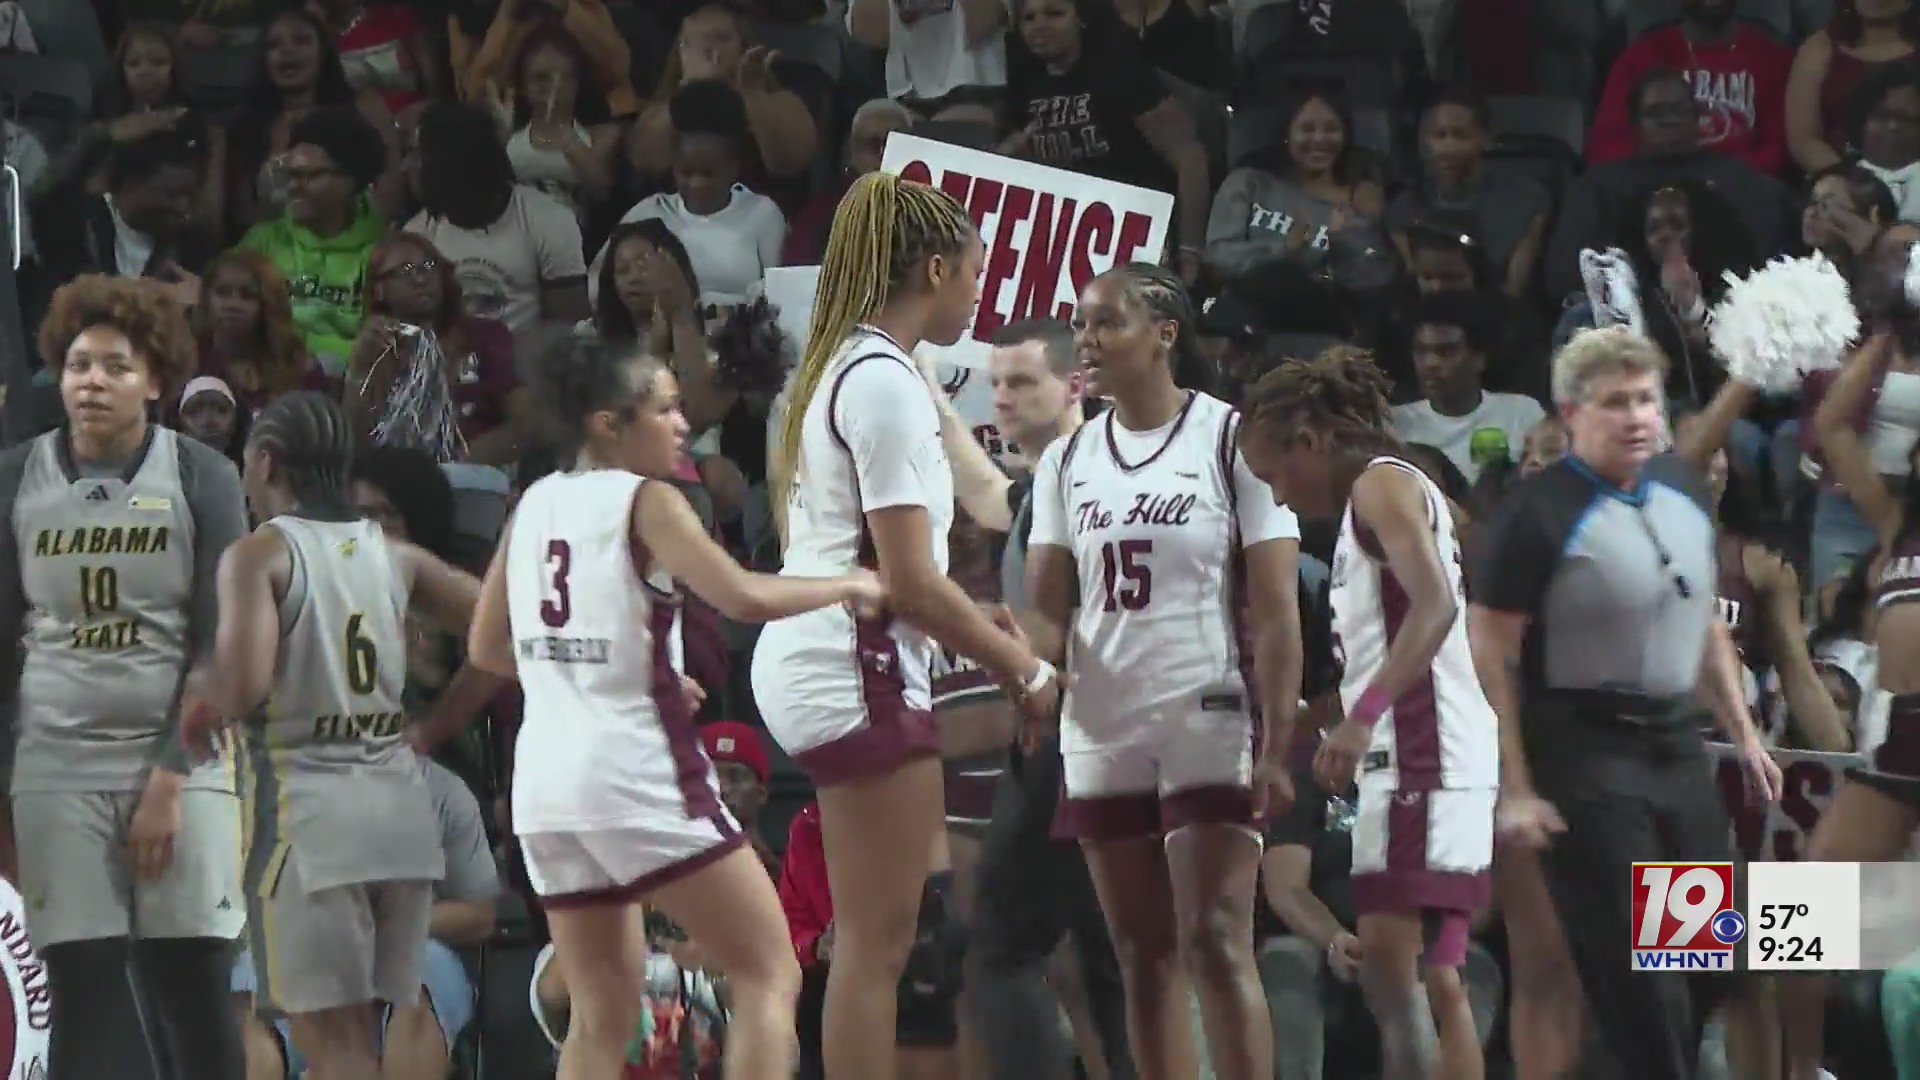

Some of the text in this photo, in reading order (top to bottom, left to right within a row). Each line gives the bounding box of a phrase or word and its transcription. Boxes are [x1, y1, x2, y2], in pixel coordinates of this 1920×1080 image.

[1077, 493, 1198, 535] The Hill
[34, 526, 169, 557] ALABAMA
[80, 565, 118, 618] 10
[540, 539, 570, 629] 3
[1101, 539, 1153, 613] 15
[70, 620, 143, 650] STATE
[346, 612, 378, 696] 6
